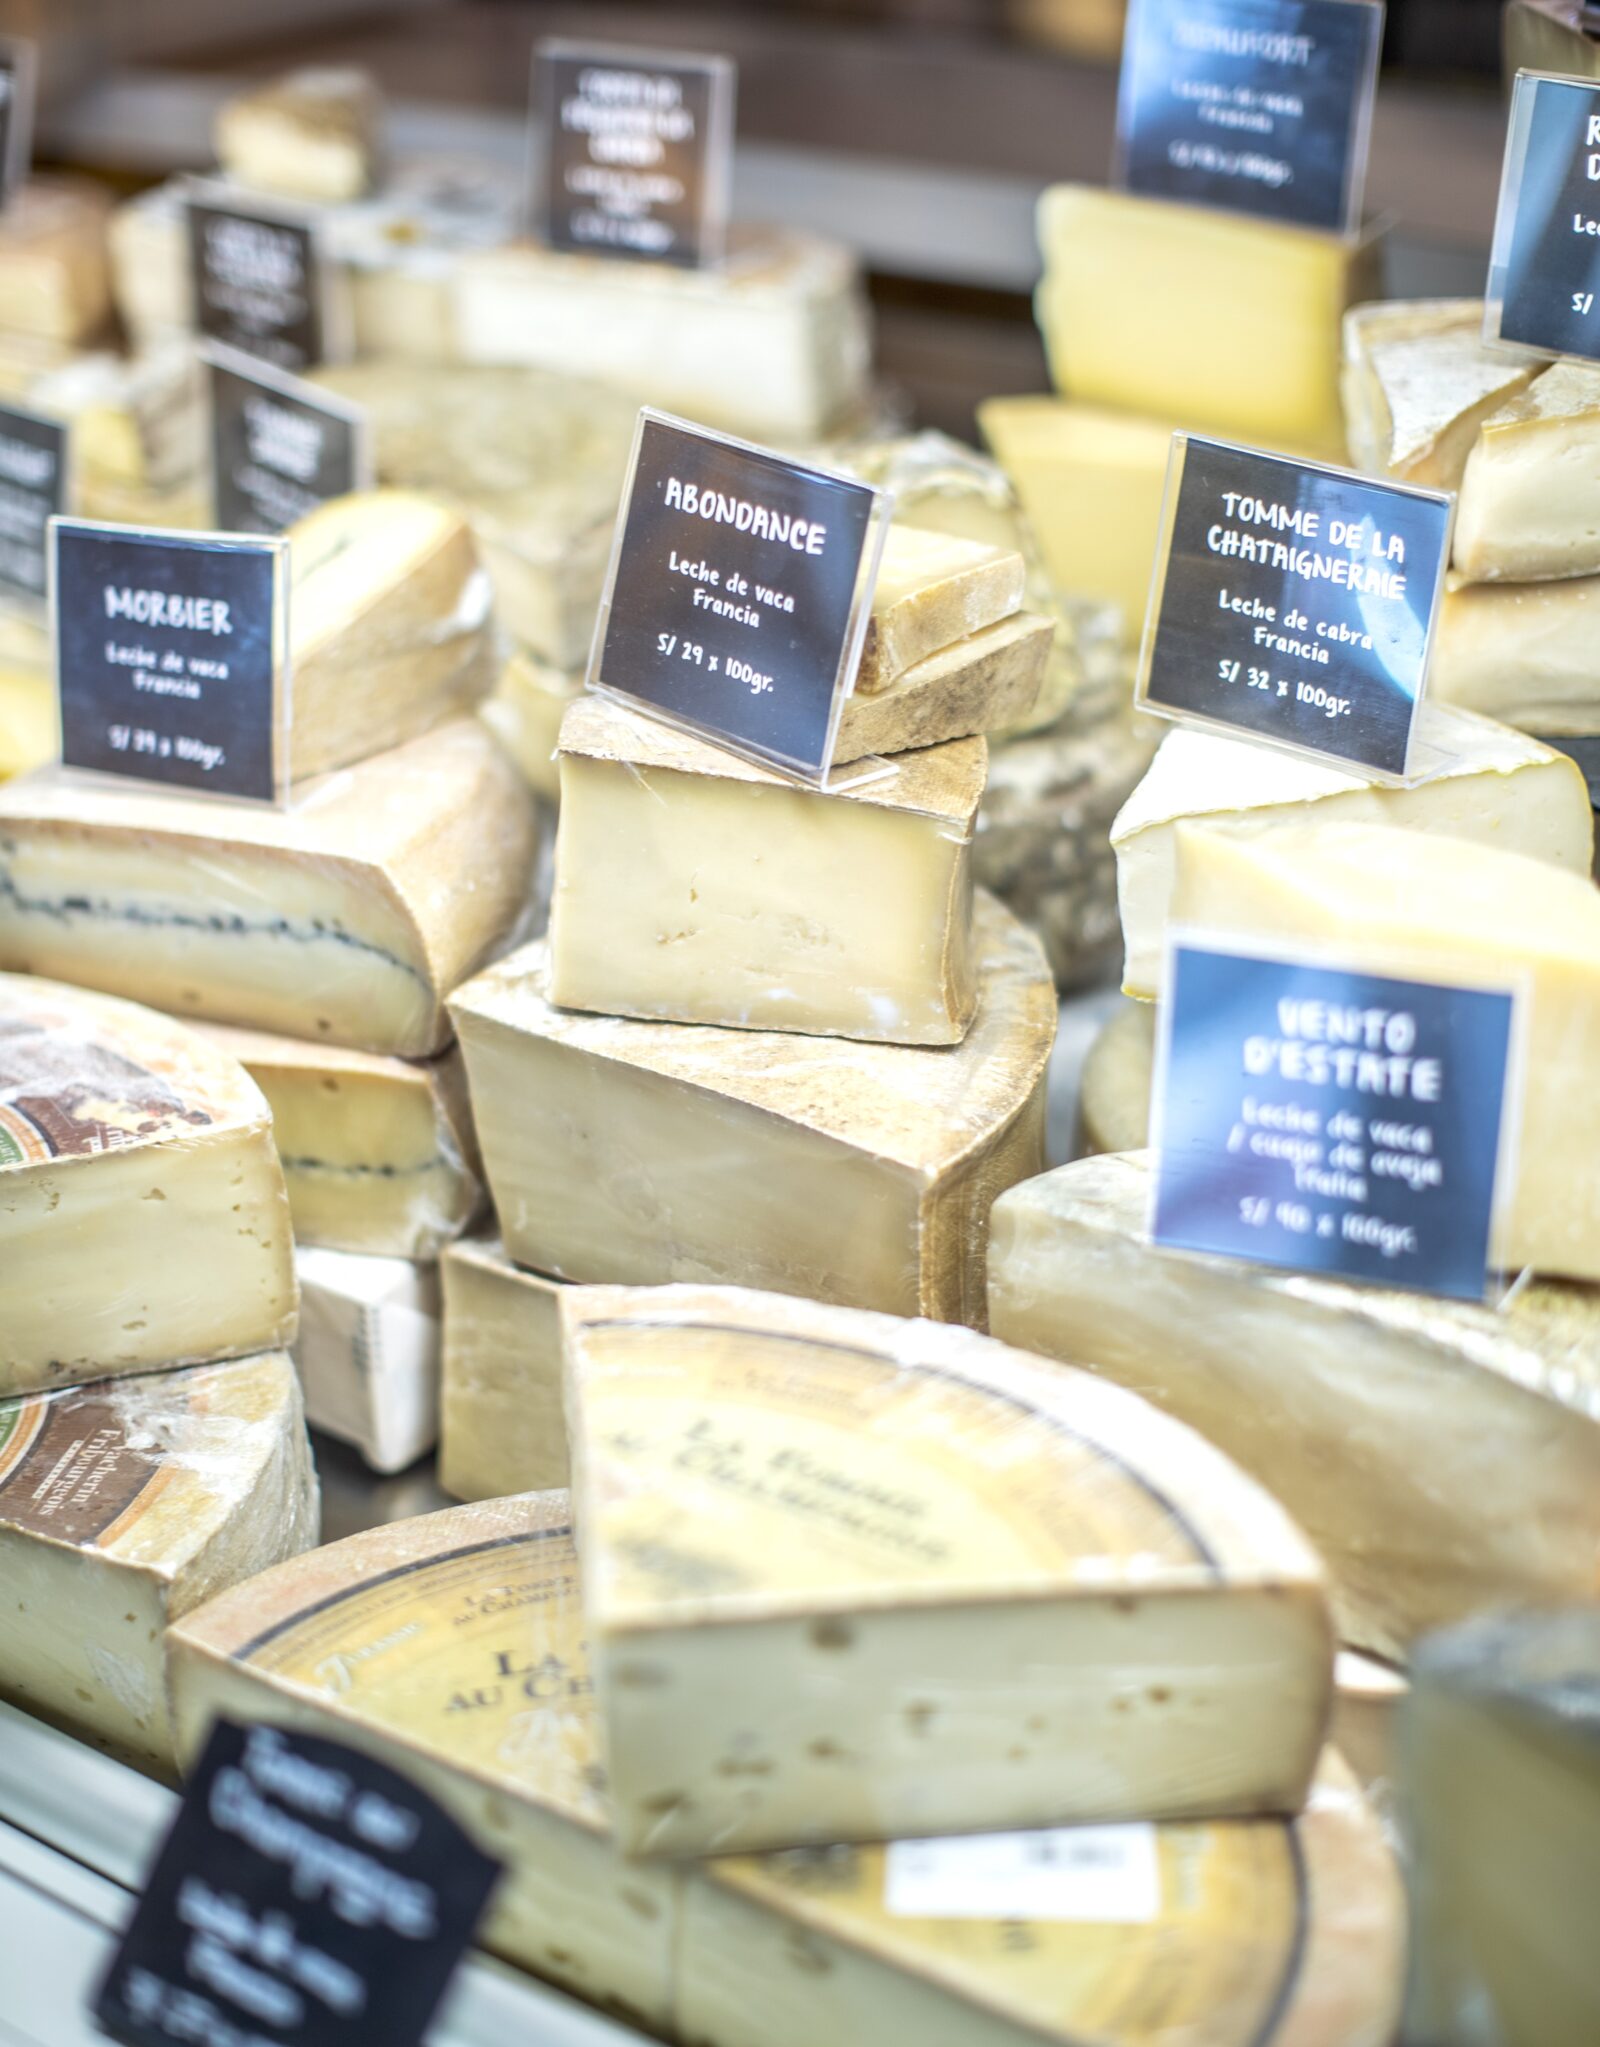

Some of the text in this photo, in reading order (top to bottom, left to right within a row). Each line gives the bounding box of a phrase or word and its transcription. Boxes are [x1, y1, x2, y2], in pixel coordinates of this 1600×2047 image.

[1571, 293, 1594, 315] S/
[664, 477, 827, 555] ABONDANCE
[1222, 491, 1405, 564] TOMME DE LA
[668, 551, 796, 614] Leche de vaca
[1207, 524, 1408, 600] CHATAIGNERAIE
[104, 585, 233, 636] MORBIER
[693, 587, 760, 628] Francia
[1218, 588, 1374, 650] Leche de cabra
[105, 641, 229, 680] Leche de vaca
[656, 633, 774, 695] S/ 29 x 100gr.
[1254, 626, 1329, 664] Francia
[132, 669, 201, 699] Francia
[1218, 659, 1351, 718] S/ 32 x 100gr.
[1277, 997, 1416, 1054] VENTO
[1243, 1035, 1442, 1102] D'ESTATE
[1242, 1095, 1433, 1154] Leche de vaca
[1329, 1141, 1366, 1173] de
[1370, 1151, 1442, 1191] oveja
[38, 1429, 121, 1515] Fribourgeois
